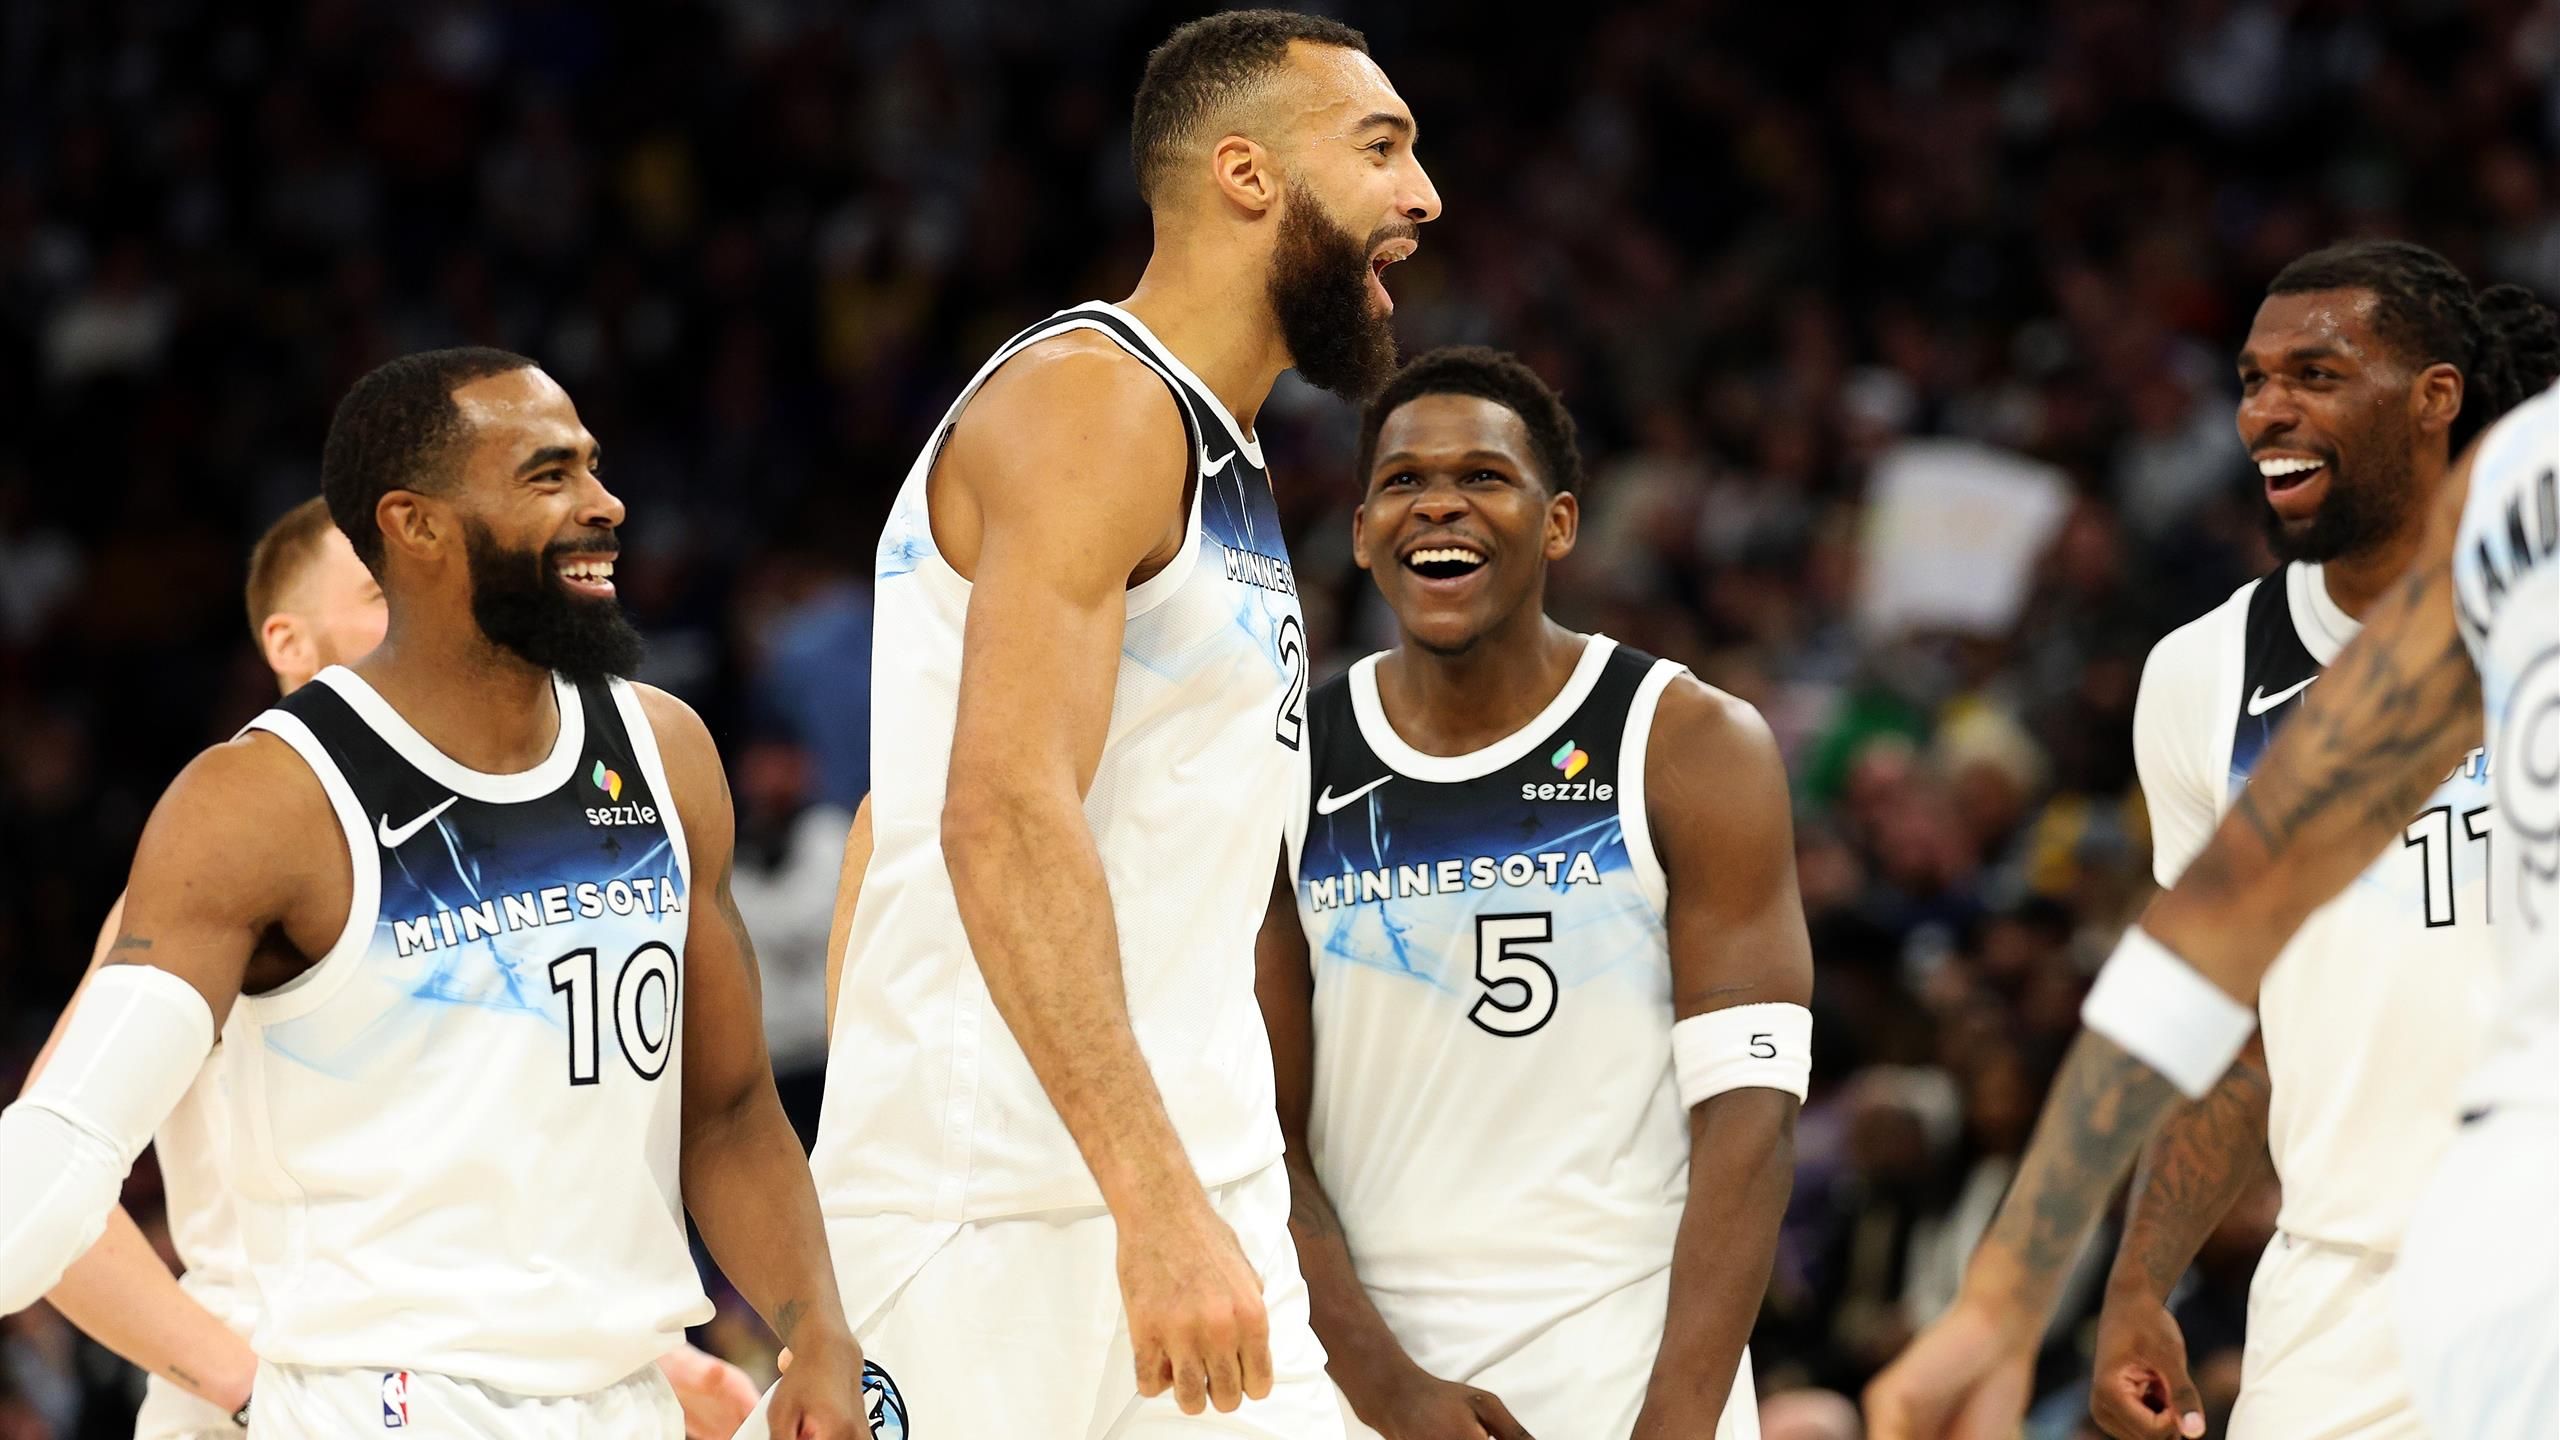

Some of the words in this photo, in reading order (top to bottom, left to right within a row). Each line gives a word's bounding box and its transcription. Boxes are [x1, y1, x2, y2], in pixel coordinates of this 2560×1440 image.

[1223, 544, 1298, 598] MINNES
[1276, 614, 1308, 751] 2
[585, 800, 657, 826] sezzle
[1521, 778, 1614, 801] sezzle
[1308, 851, 1602, 912] MINNESOTA
[392, 876, 681, 958] MINNESOTA
[1467, 911, 1559, 1038] 5
[548, 940, 679, 1087] 10
[1749, 1033, 1777, 1059] 5
